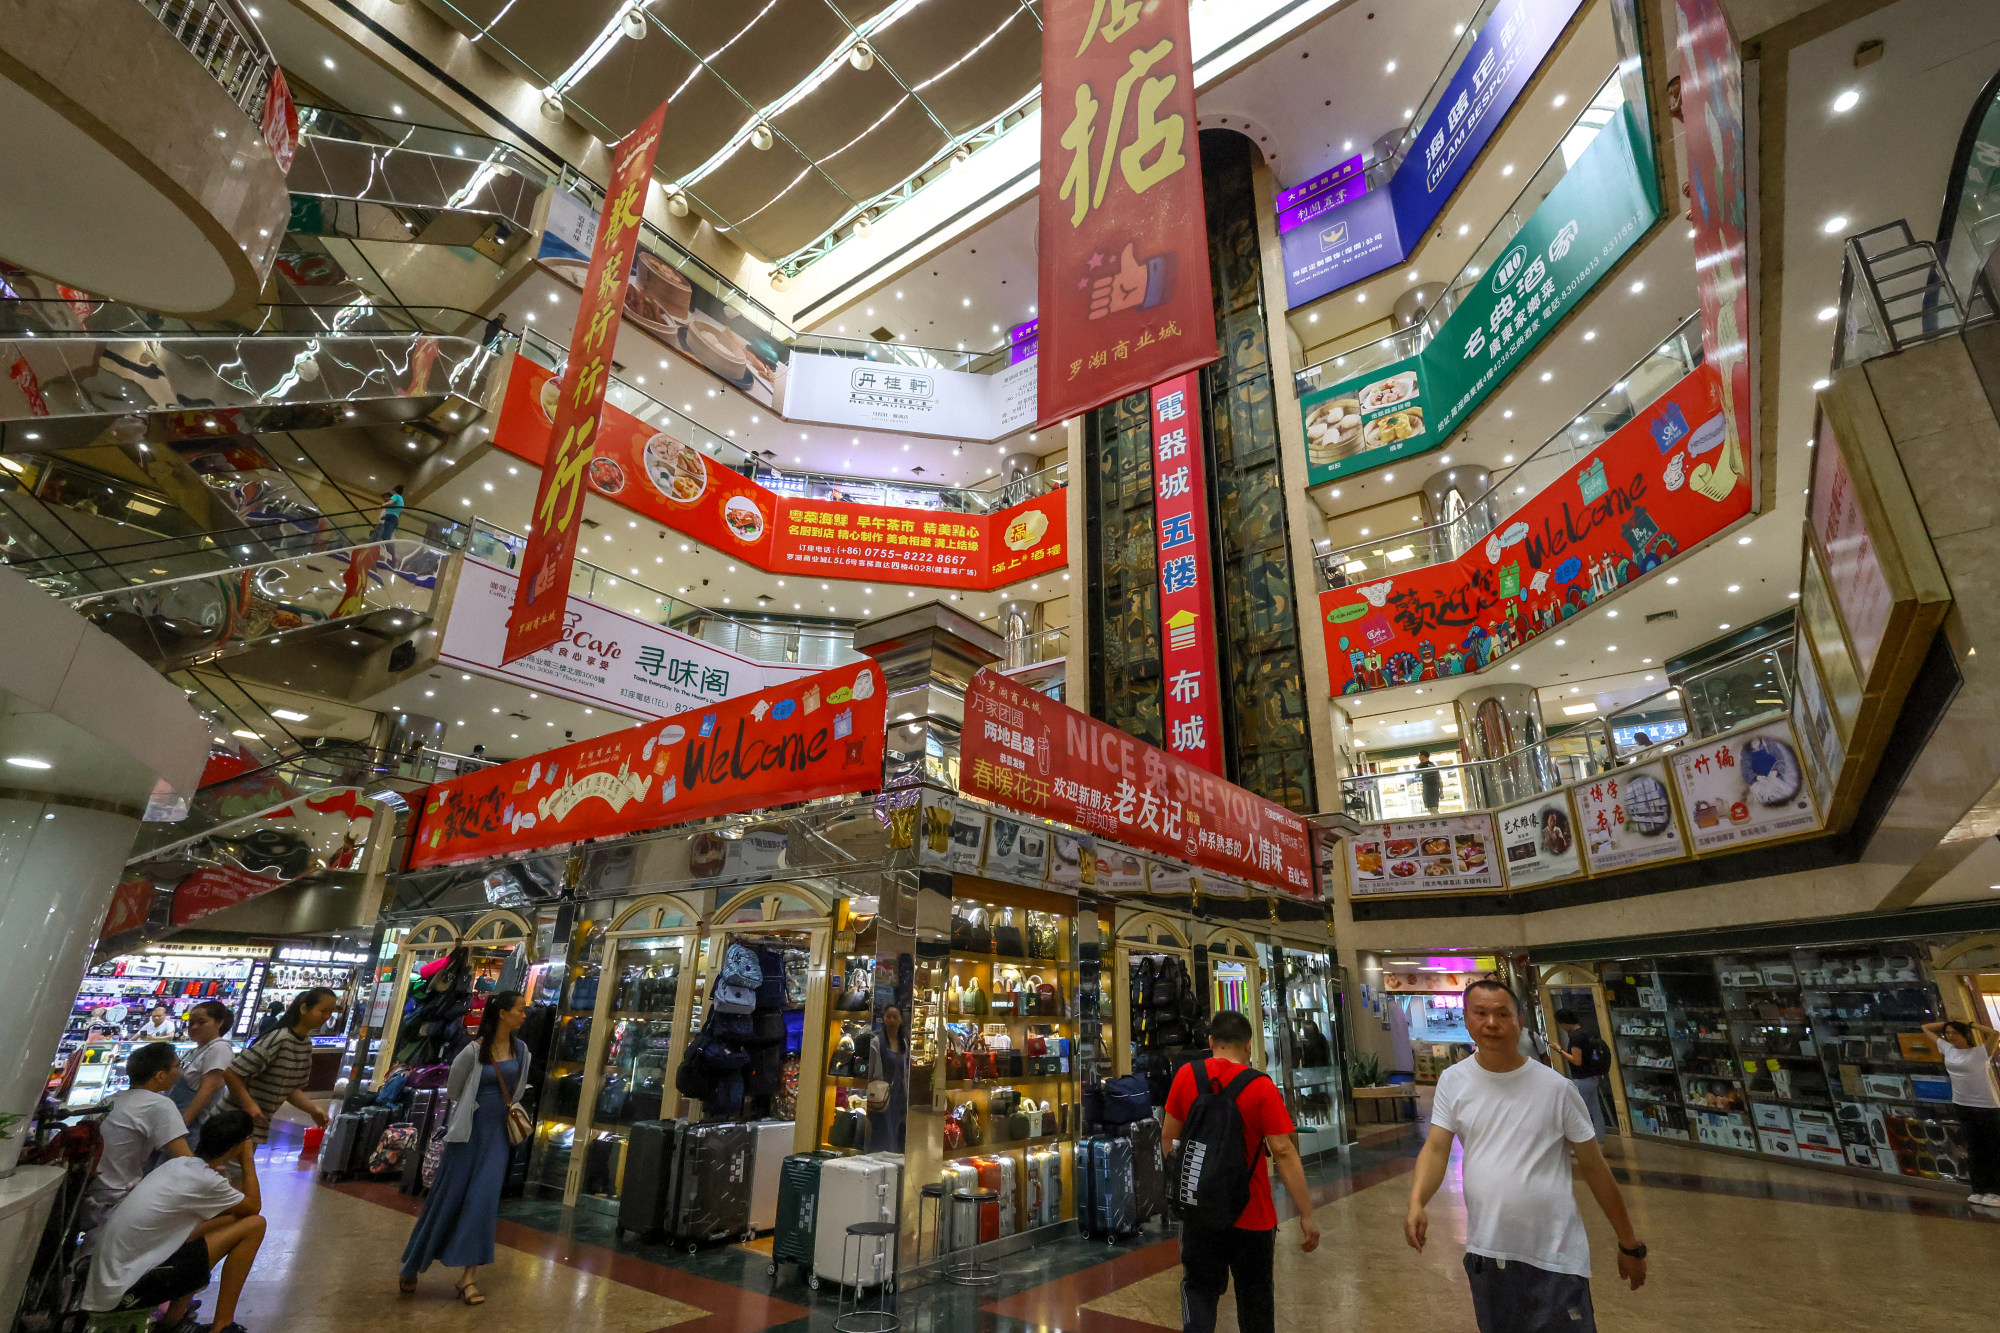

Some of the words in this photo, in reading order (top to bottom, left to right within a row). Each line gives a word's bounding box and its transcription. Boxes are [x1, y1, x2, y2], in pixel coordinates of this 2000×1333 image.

[1432, 129, 1466, 183] HILAM
[1468, 41, 1522, 129] BESPOKE
[1463, 219, 1578, 359] 名典酒家
[1489, 277, 1555, 358] 廣東家鄉菜
[1067, 320, 1182, 381] 罗湖商业城
[858, 372, 928, 394] 丹桂軒
[857, 516, 915, 533] 早午茶市
[1525, 473, 1648, 569] Welcome
[937, 555, 967, 565] 8667
[633, 674, 648, 684] Taste
[649, 679, 672, 693] Everyday
[681, 689, 691, 698] The
[635, 646, 729, 696] 寻味阁
[971, 691, 1024, 730] 万家团圆
[988, 680, 1042, 715] 罗湖商业城
[1170, 668, 1206, 752] 布城
[683, 717, 828, 791] Welcome
[984, 720, 1035, 757] 两地昌盛
[1000, 752, 1025, 771] 恭喜发财
[972, 758, 1050, 808] 春暖花开
[1067, 714, 1136, 781] NICE
[1175, 764, 1217, 814] SEE
[1218, 782, 1261, 831] YOU
[1053, 777, 1114, 813] 欢迎新朋友
[1112, 778, 1183, 841] 老友记
[1075, 805, 1118, 834] 吉祥如意
[1198, 828, 1242, 858] 仲系熟悉的
[1243, 833, 1284, 875] 人情味
[1179, 1140, 1207, 1206] PUMA
